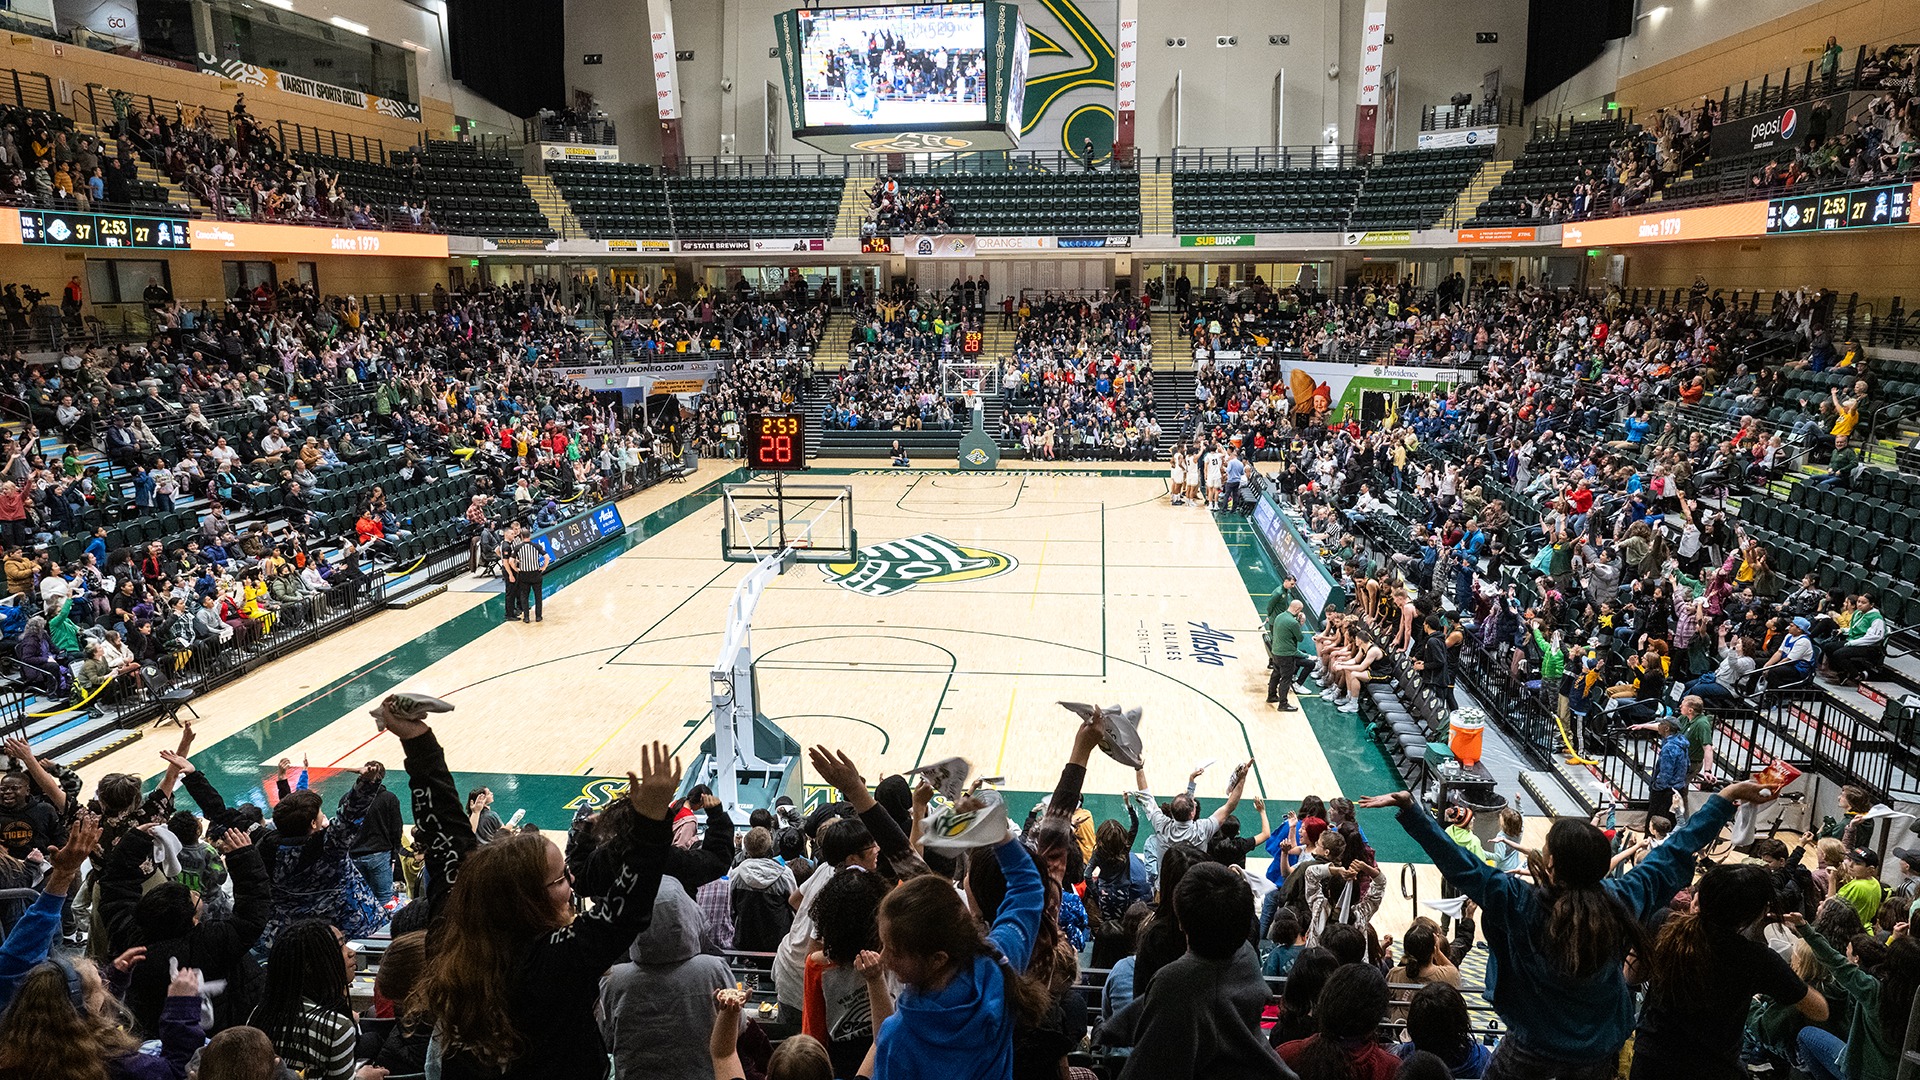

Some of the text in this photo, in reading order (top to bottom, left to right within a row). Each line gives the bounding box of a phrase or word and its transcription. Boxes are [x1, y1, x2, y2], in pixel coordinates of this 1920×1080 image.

[108, 18, 126, 28] GCI
[280, 74, 364, 108] VARSITY SPORTS GRILL
[1750, 116, 1781, 142] pepsi
[1823, 197, 1846, 215] 2:53
[1852, 202, 1867, 220] 27
[38, 218, 42, 226] 3
[1802, 208, 1816, 224] 37
[39, 230, 44, 238] 9
[76, 224, 92, 240] 37
[100, 220, 127, 235] 2:53
[136, 228, 150, 242] 27
[1638, 218, 1681, 237] since 1979
[331, 234, 380, 250] since 1979
[978, 238, 1022, 248] ORANGE
[1194, 236, 1242, 246] SUBWAY
[965, 340, 978, 351] 28
[594, 365, 684, 375] WWW.YUKONEQ.COM
[1383, 368, 1418, 378] Providence
[762, 418, 797, 434] 2:53
[760, 436, 791, 462] 28
[1137, 629, 1150, 653] CENTER
[1162, 622, 1182, 660] AIRLINES
[1188, 621, 1238, 666] Alaska
[3, 830, 33, 839] TIGERS
